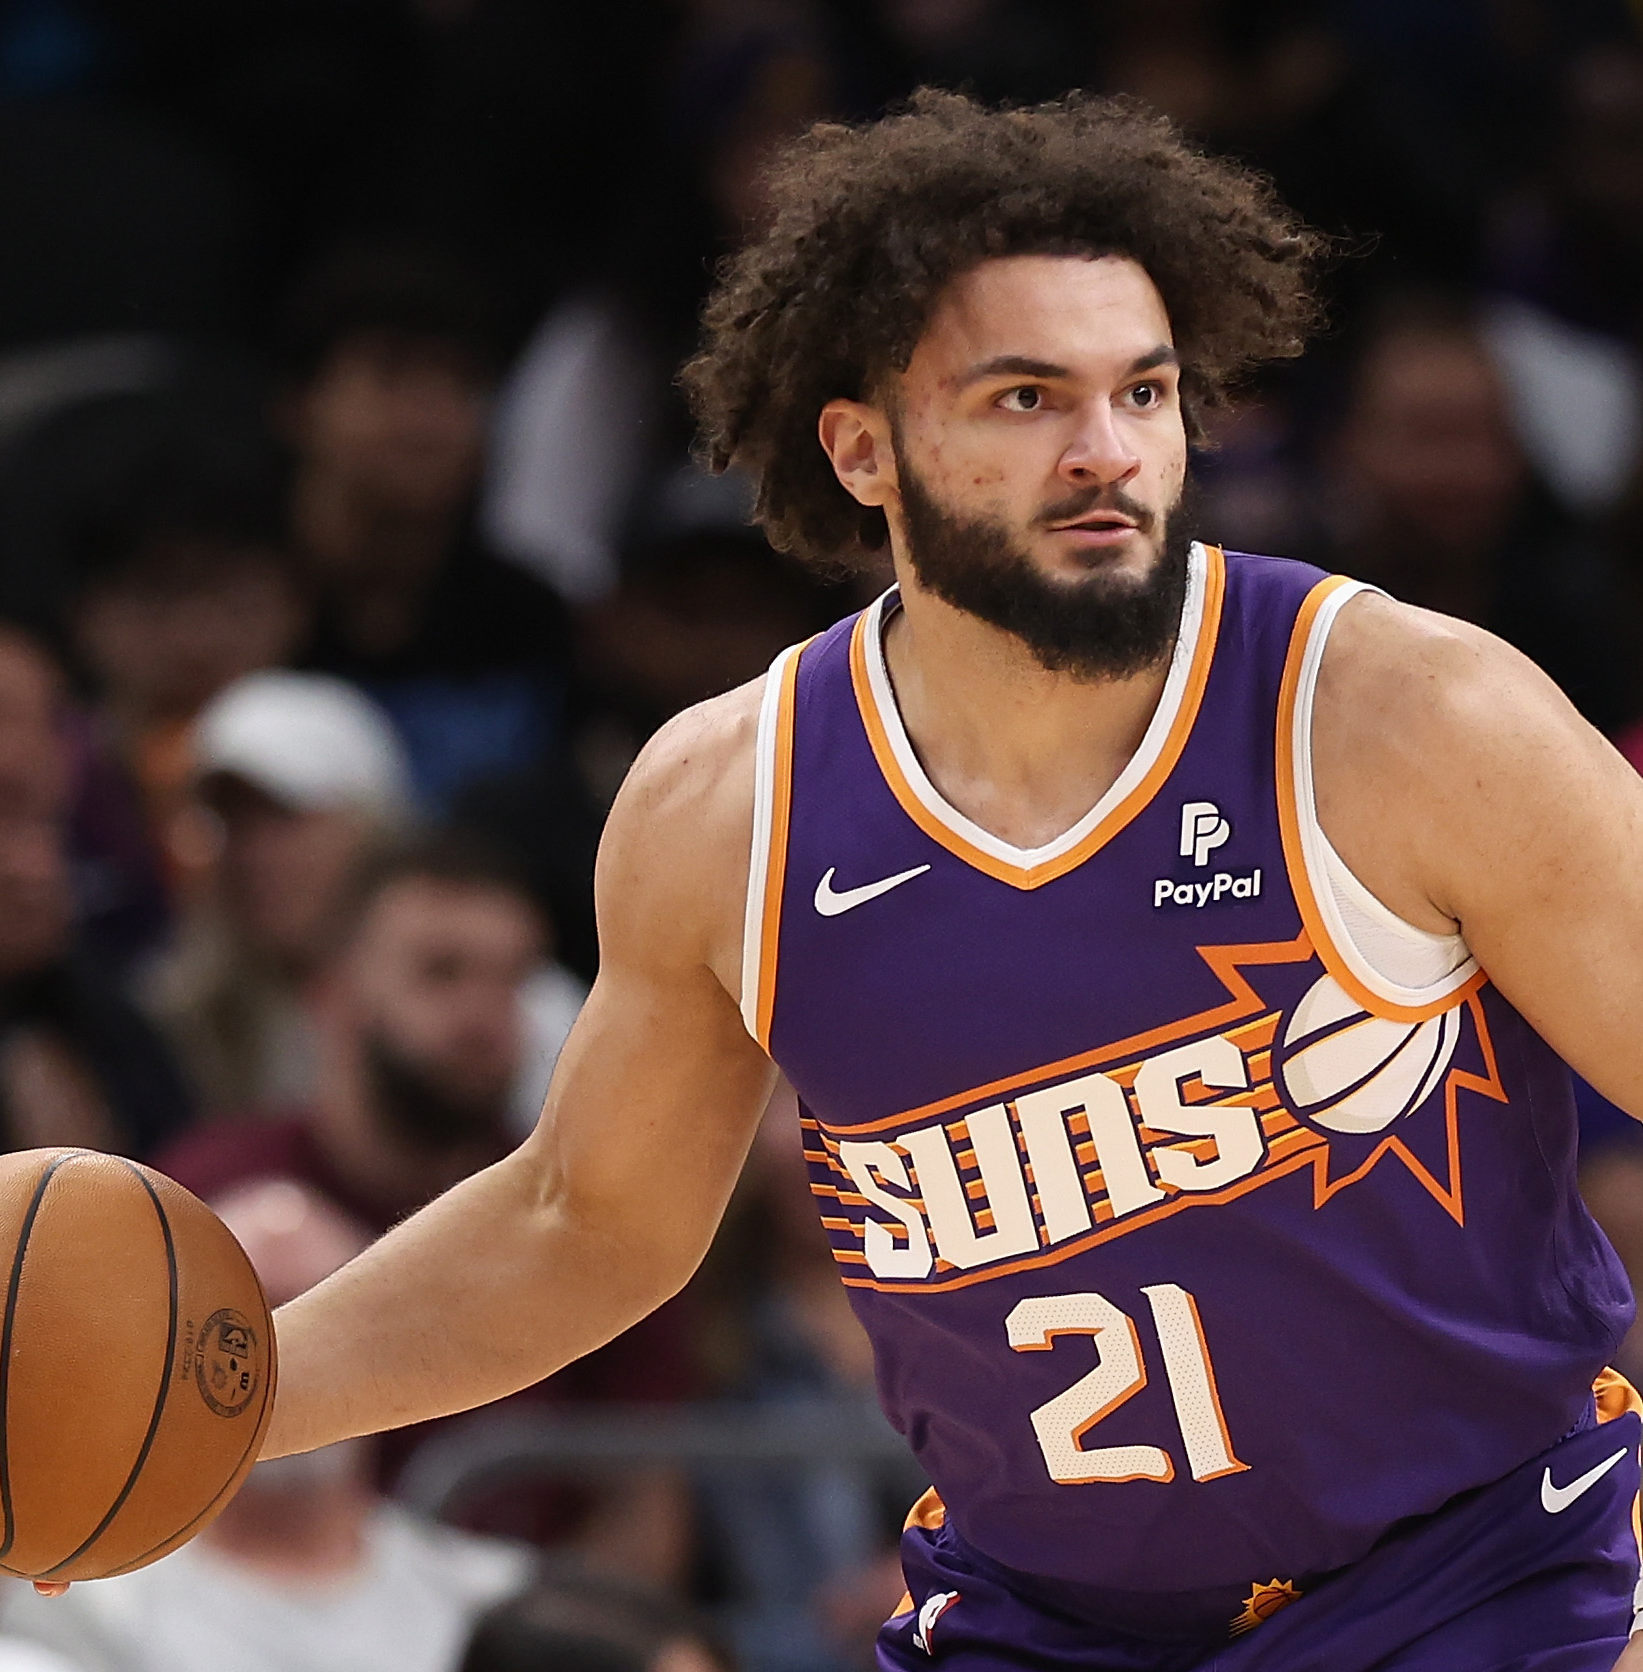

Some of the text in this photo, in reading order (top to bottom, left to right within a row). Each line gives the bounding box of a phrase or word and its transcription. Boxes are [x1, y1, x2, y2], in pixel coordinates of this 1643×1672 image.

[1154, 868, 1261, 908] PayPal
[838, 1034, 1266, 1279] SUNS
[1004, 1283, 1253, 1485] 21
